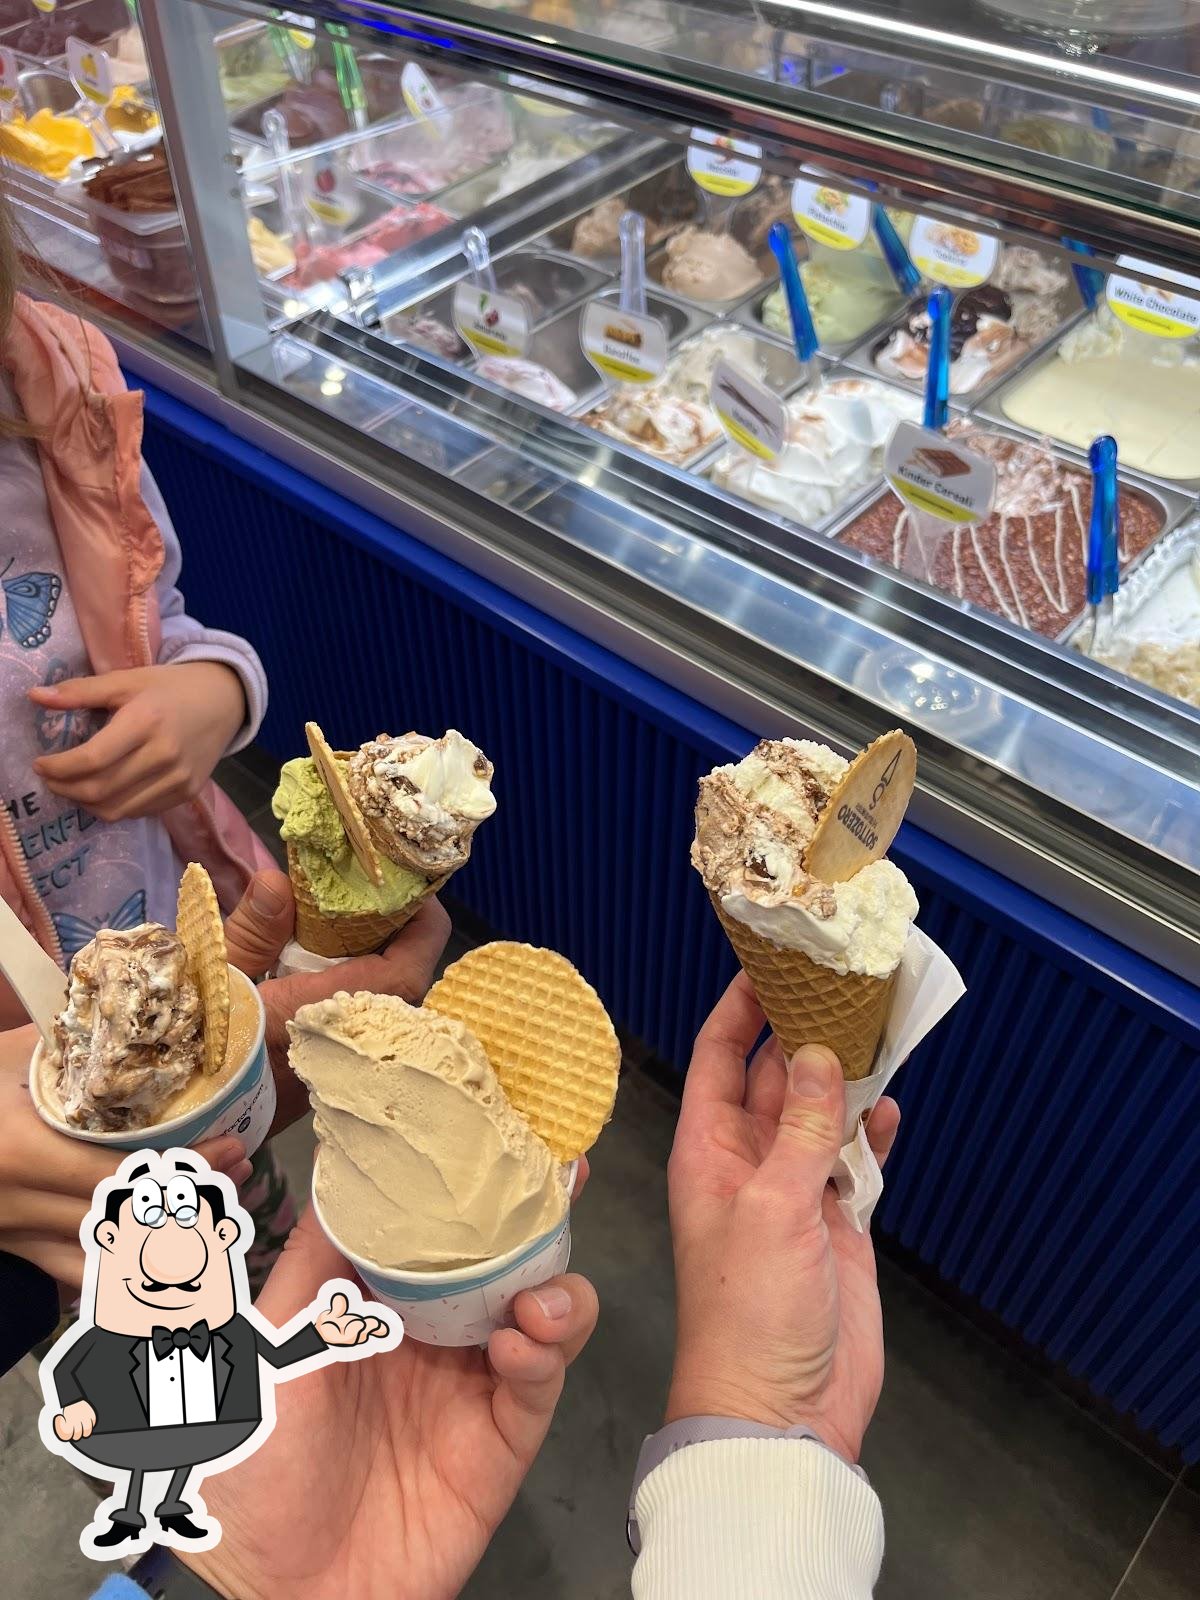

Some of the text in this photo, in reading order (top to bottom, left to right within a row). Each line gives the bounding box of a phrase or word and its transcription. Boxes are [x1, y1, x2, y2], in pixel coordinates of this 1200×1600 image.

[1114, 287, 1199, 324] White Chocolate
[897, 465, 933, 488] Kinder
[6, 791, 41, 819] HE
[837, 804, 879, 851] SOTTOZERO
[20, 807, 98, 860] ERFL
[37, 846, 91, 897] ECT
[223, 1084, 264, 1135] factory.com
